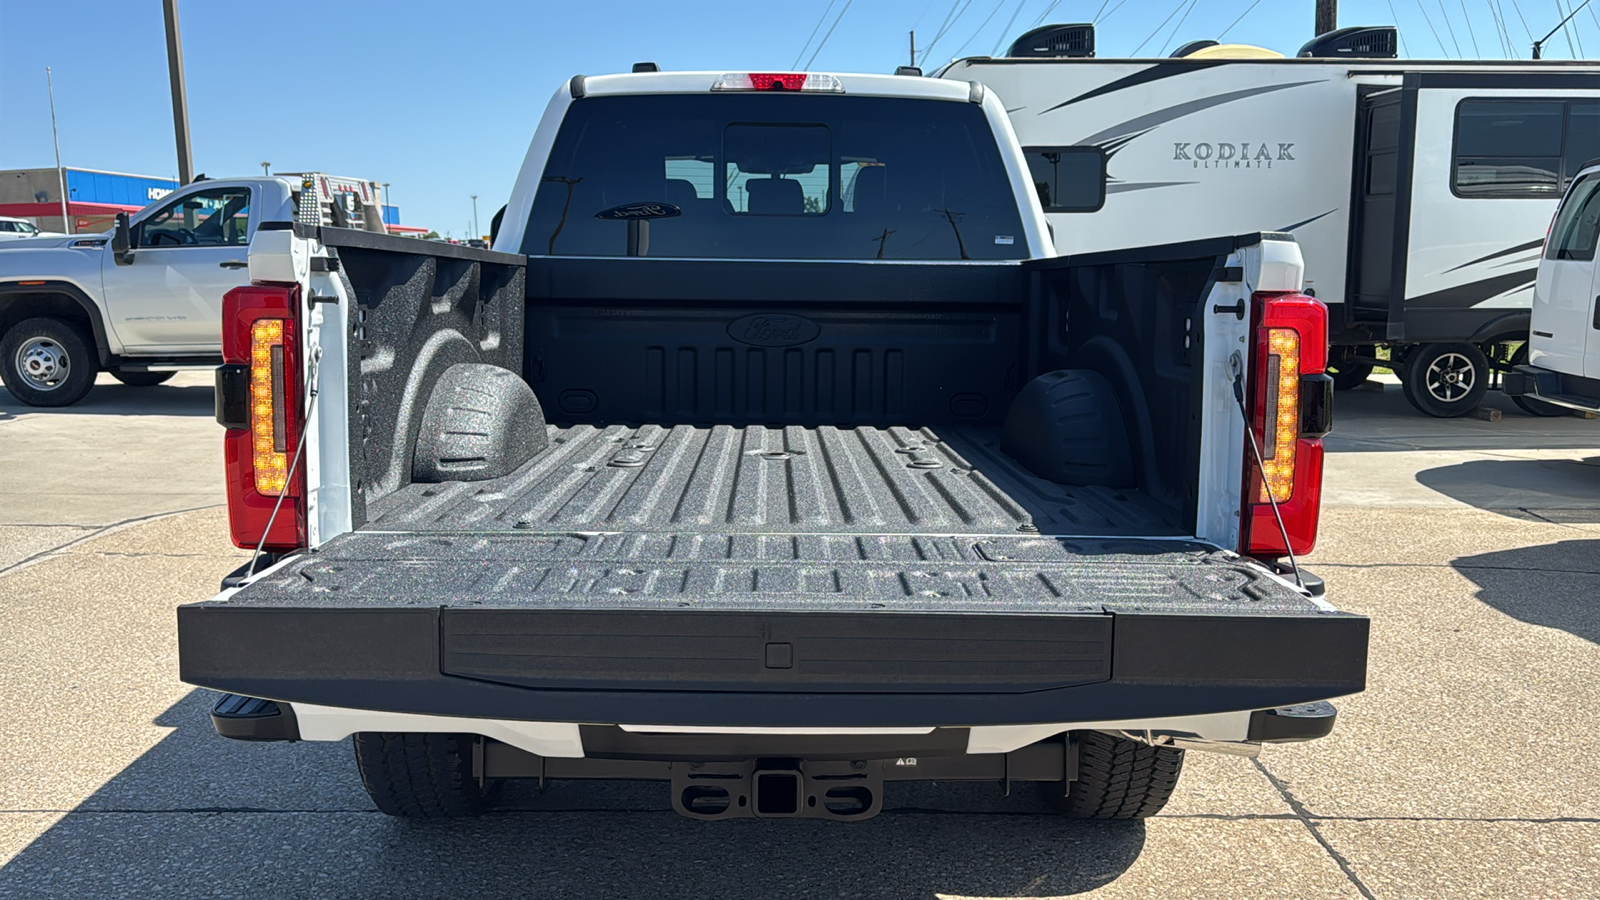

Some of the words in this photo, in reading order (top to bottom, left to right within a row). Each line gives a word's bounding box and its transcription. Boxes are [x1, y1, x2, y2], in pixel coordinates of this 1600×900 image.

[1173, 142, 1295, 160] KODIAK
[1193, 160, 1272, 168] ULTIMATE
[743, 316, 802, 340] Ford
